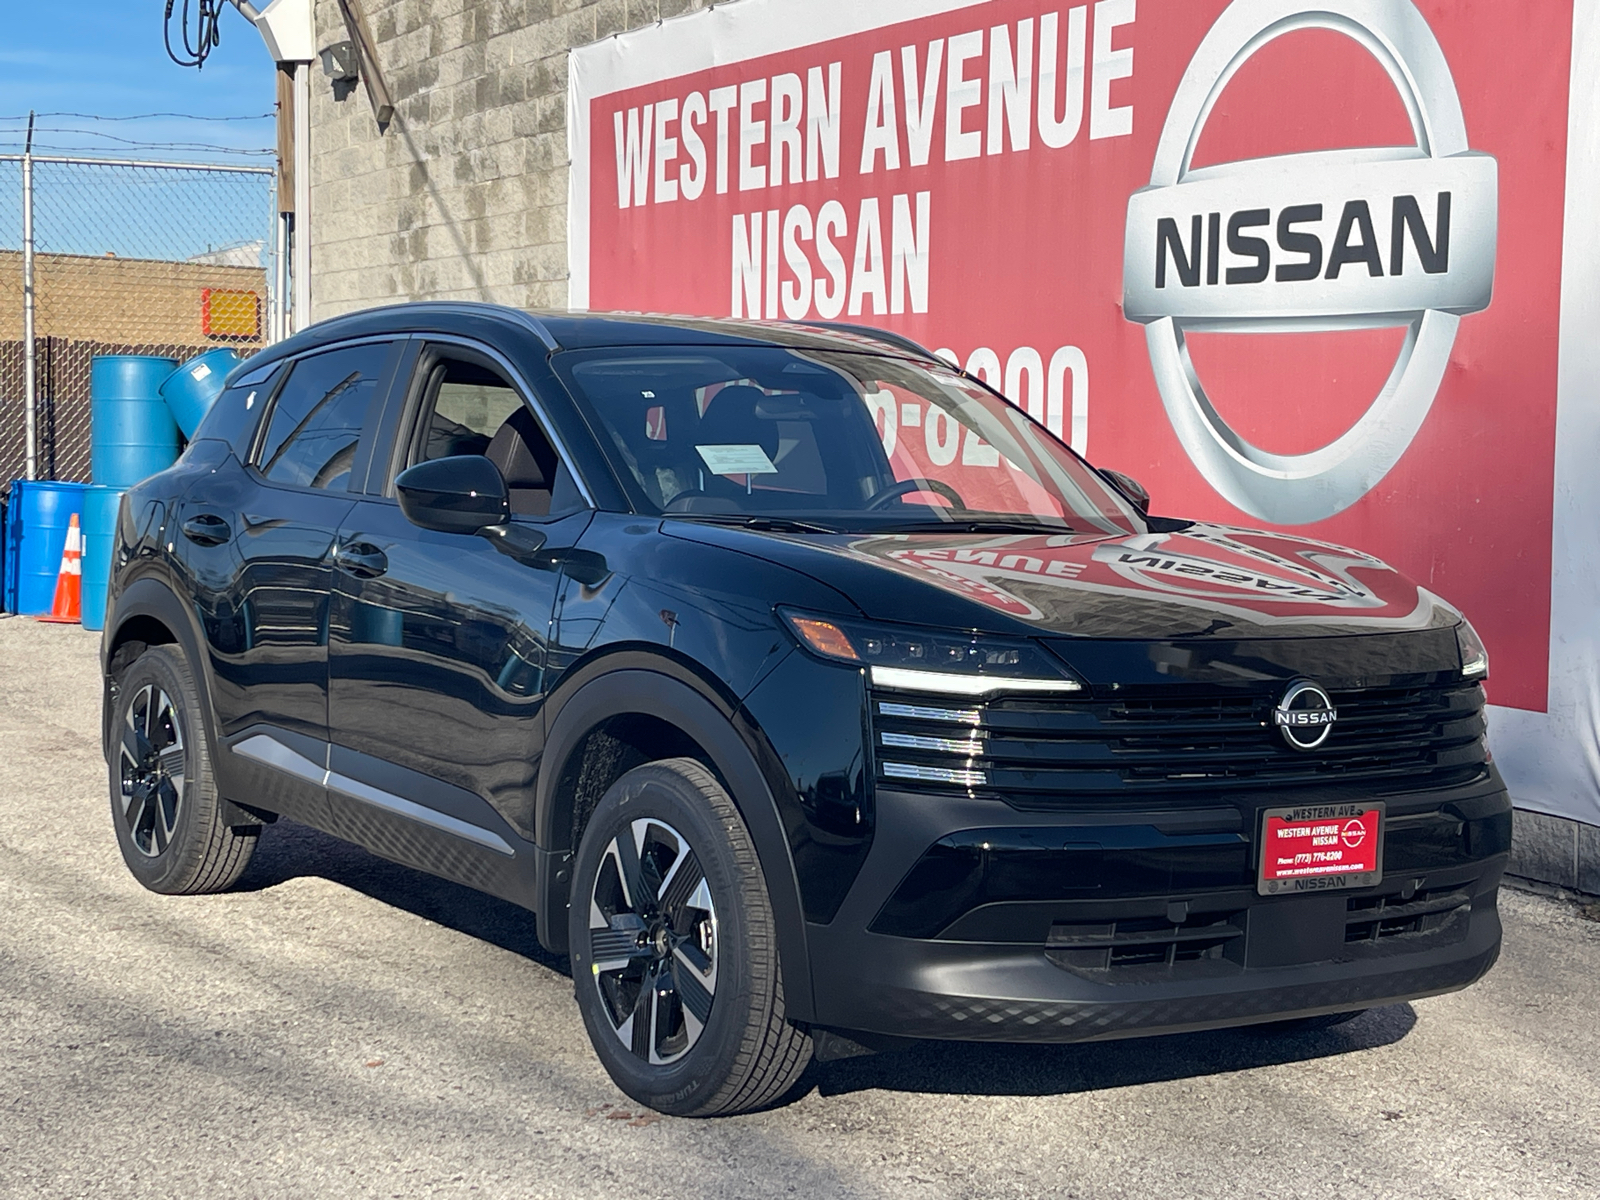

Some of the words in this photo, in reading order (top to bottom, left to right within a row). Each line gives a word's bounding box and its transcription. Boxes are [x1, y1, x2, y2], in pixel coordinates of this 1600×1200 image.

[613, 61, 843, 210] WESTERN
[859, 0, 1137, 174] AVENUE
[1154, 190, 1452, 289] NISSAN
[731, 191, 931, 321] NISSAN
[1277, 710, 1337, 724] NISSAN
[1292, 806, 1337, 820] WESTERN
[1277, 826, 1311, 839] WESTERN
[1311, 824, 1340, 837] AVENUE
[1341, 829, 1366, 837] NISSAN
[1312, 835, 1339, 847] NISSAN
[1277, 857, 1294, 865] Phone:
[1294, 852, 1312, 865] (773)
[1312, 850, 1343, 863] 776-8200
[1294, 876, 1347, 891] NISSAN
